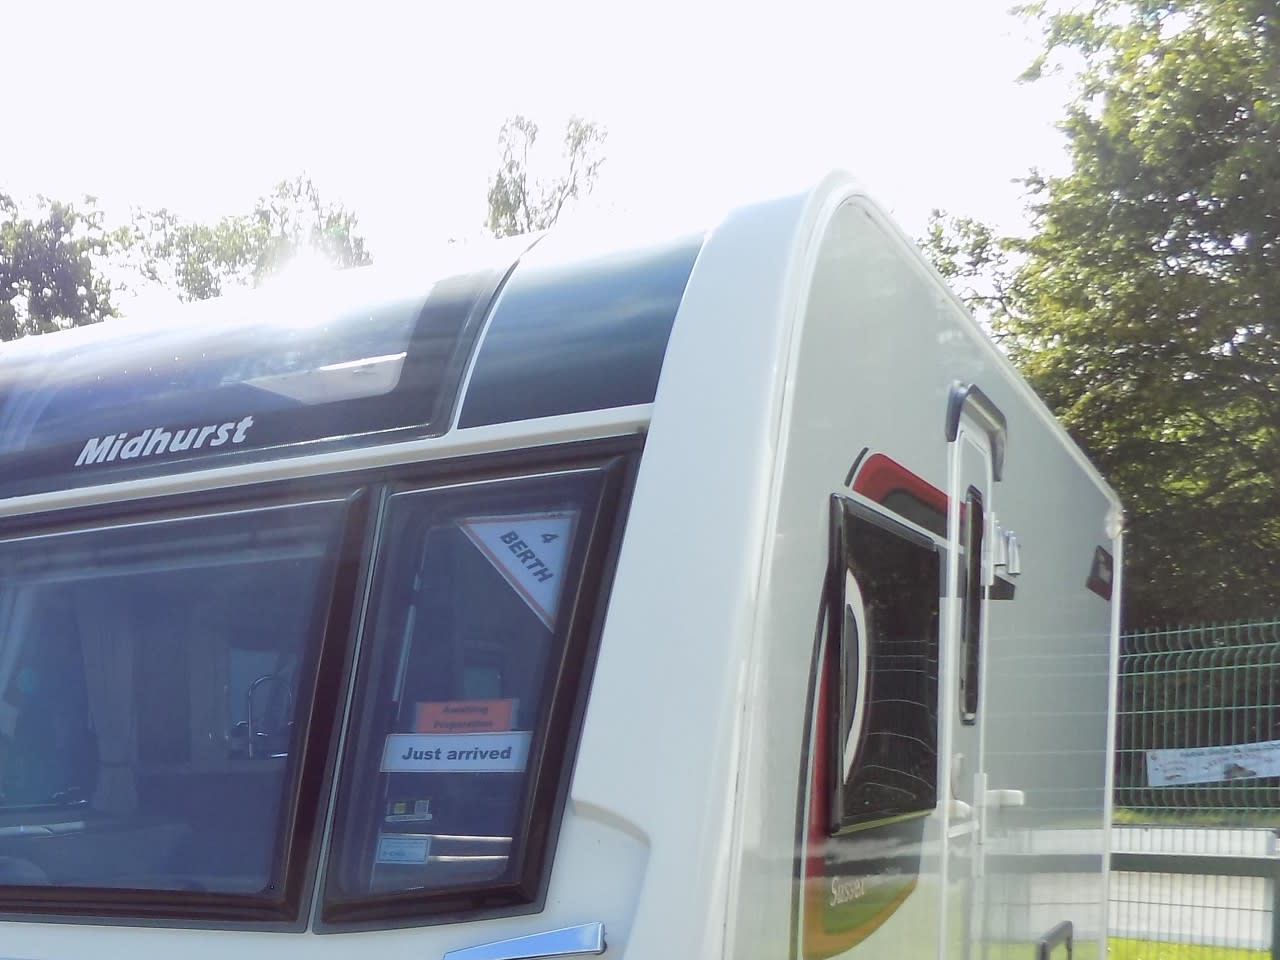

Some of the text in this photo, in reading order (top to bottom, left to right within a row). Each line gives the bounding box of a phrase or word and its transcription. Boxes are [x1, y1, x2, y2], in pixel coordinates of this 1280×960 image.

[74, 416, 254, 467] Midhurst
[541, 533, 559, 543] 4
[500, 531, 554, 583] BERTH
[401, 747, 511, 760] Just arrived
